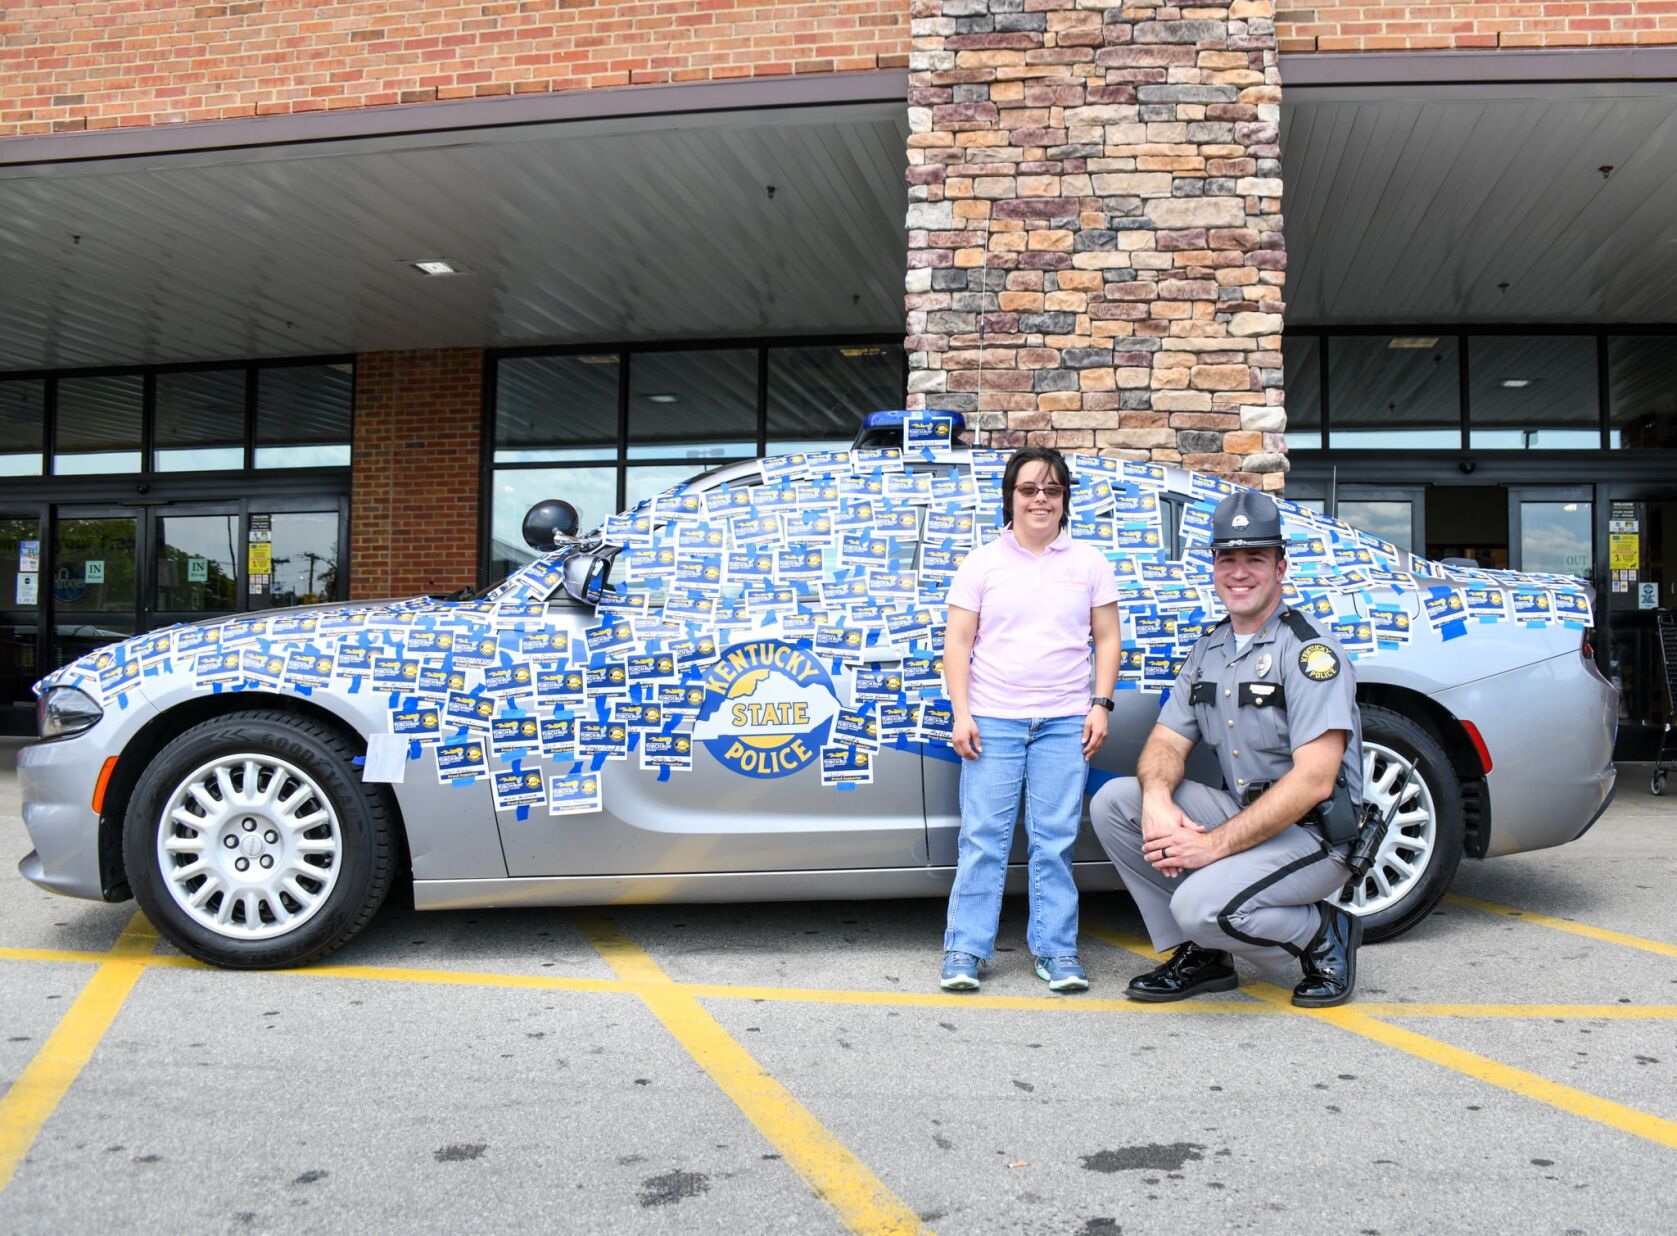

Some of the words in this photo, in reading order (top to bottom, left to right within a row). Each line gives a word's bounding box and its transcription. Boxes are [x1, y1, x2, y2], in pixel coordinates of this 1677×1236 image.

[192, 562, 204, 572] IN
[1566, 555, 1586, 566] OUT
[90, 564, 102, 574] IN
[1300, 644, 1332, 662] KENTUCKY
[706, 644, 820, 695] KENTUCKY
[1309, 668, 1336, 679] POLICE
[732, 702, 810, 727] STATE
[724, 739, 812, 774] POLICE
